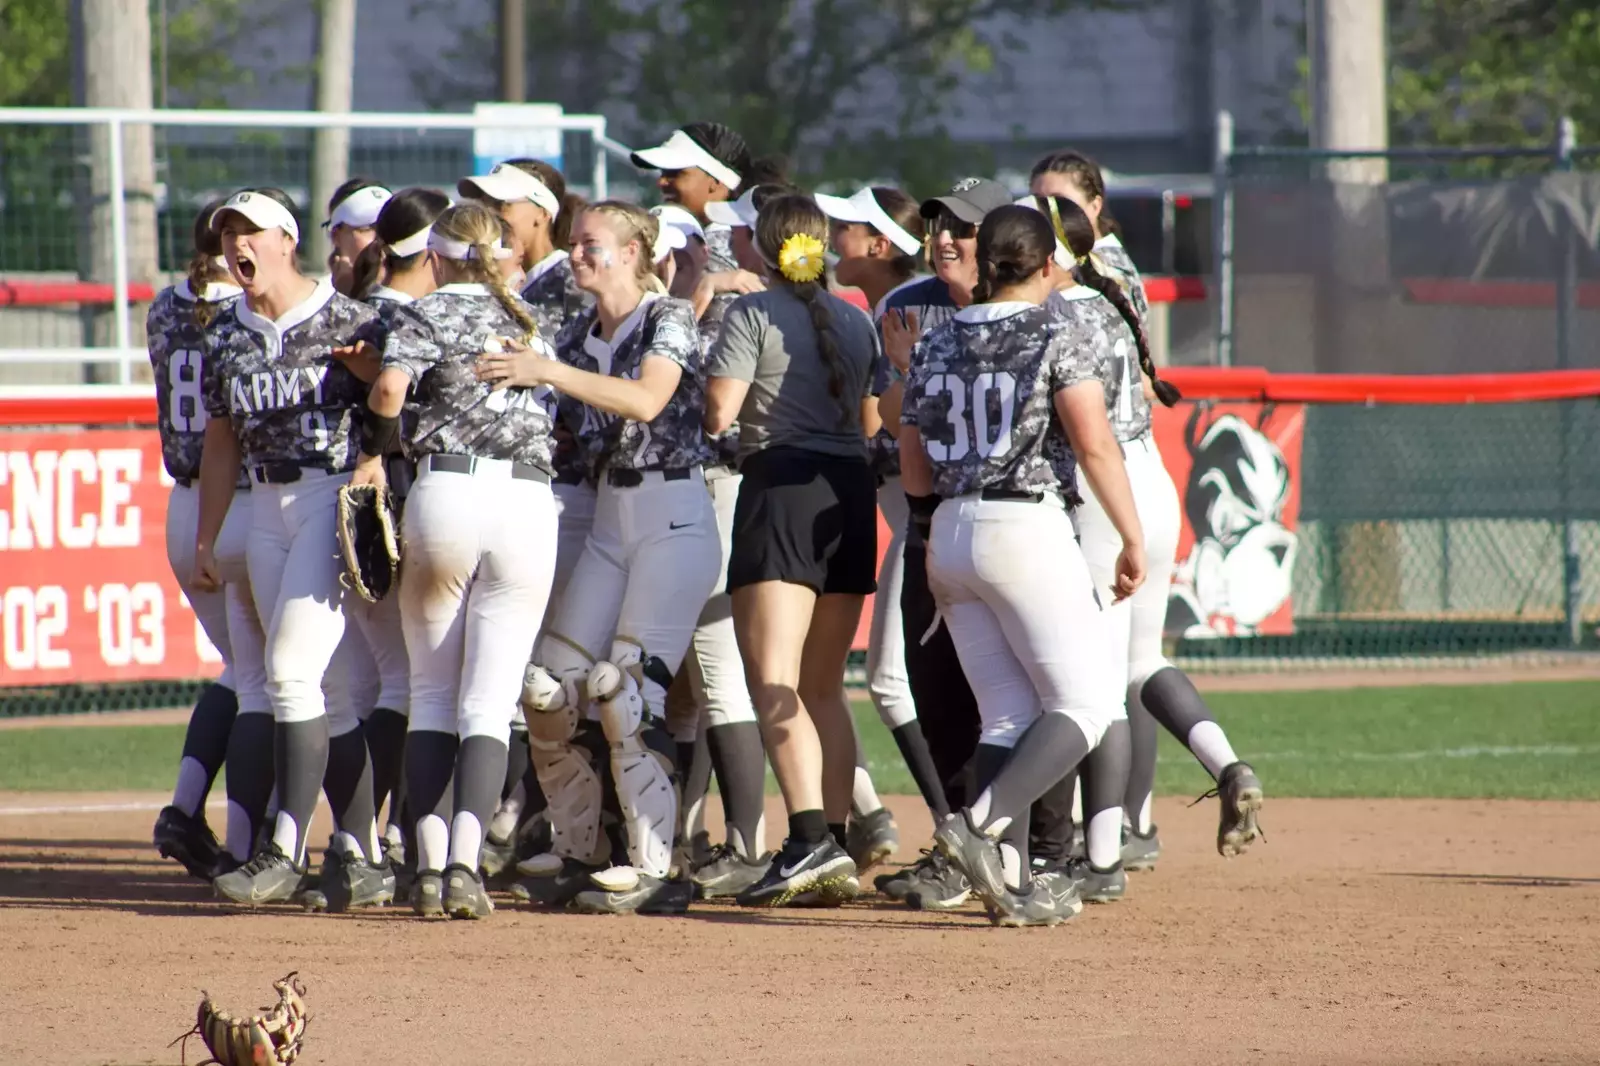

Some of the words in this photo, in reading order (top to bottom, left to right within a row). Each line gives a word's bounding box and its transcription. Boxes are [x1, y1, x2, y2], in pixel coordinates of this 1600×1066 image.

[169, 349, 206, 433] 8
[230, 365, 329, 415] ARMY
[300, 410, 328, 452] 9
[924, 371, 1017, 462] 30
[626, 423, 660, 469] 2
[0, 448, 142, 549] NCE
[0, 585, 71, 670] 02
